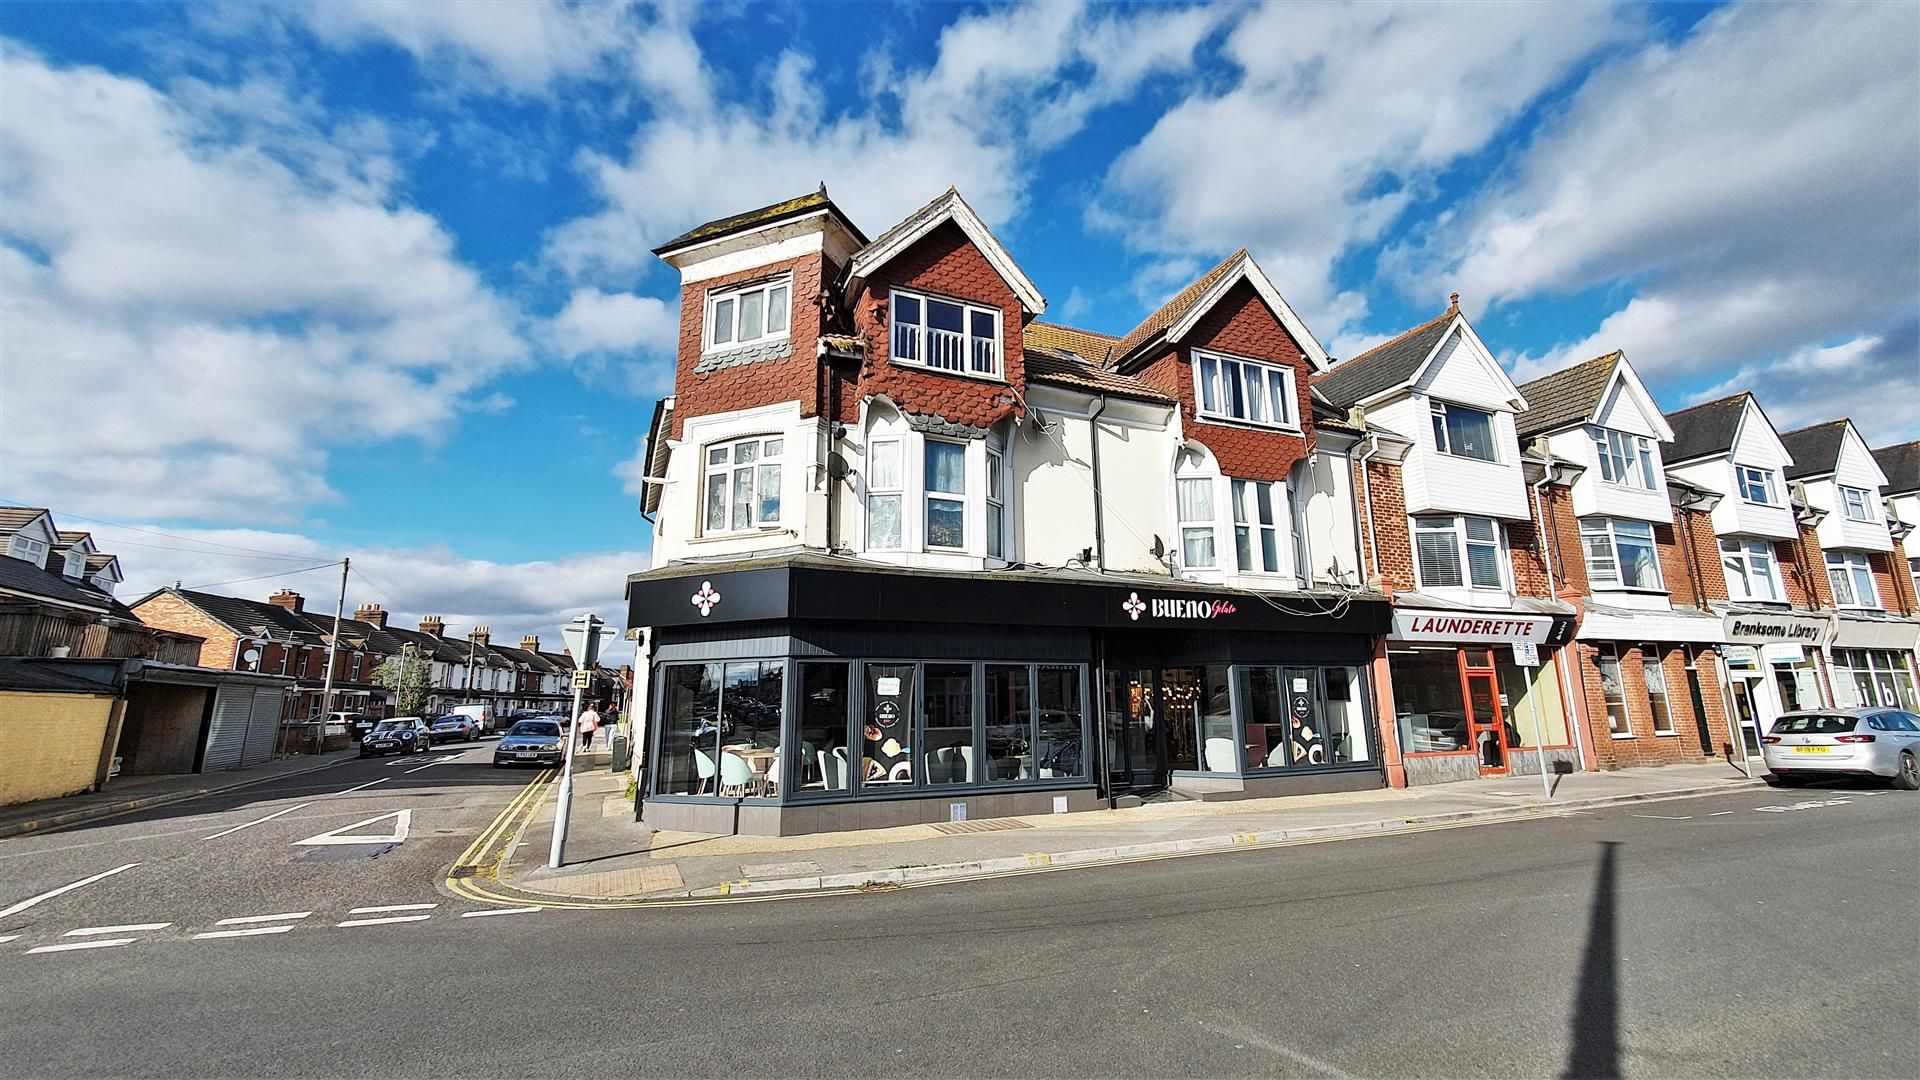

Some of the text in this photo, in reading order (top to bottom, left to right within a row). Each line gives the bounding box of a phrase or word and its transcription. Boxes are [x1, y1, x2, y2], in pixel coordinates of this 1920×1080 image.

[1152, 598, 1211, 619] BUENO
[1411, 617, 1534, 636] LAUNDERETTE
[1732, 620, 1820, 641] Branksome Library
